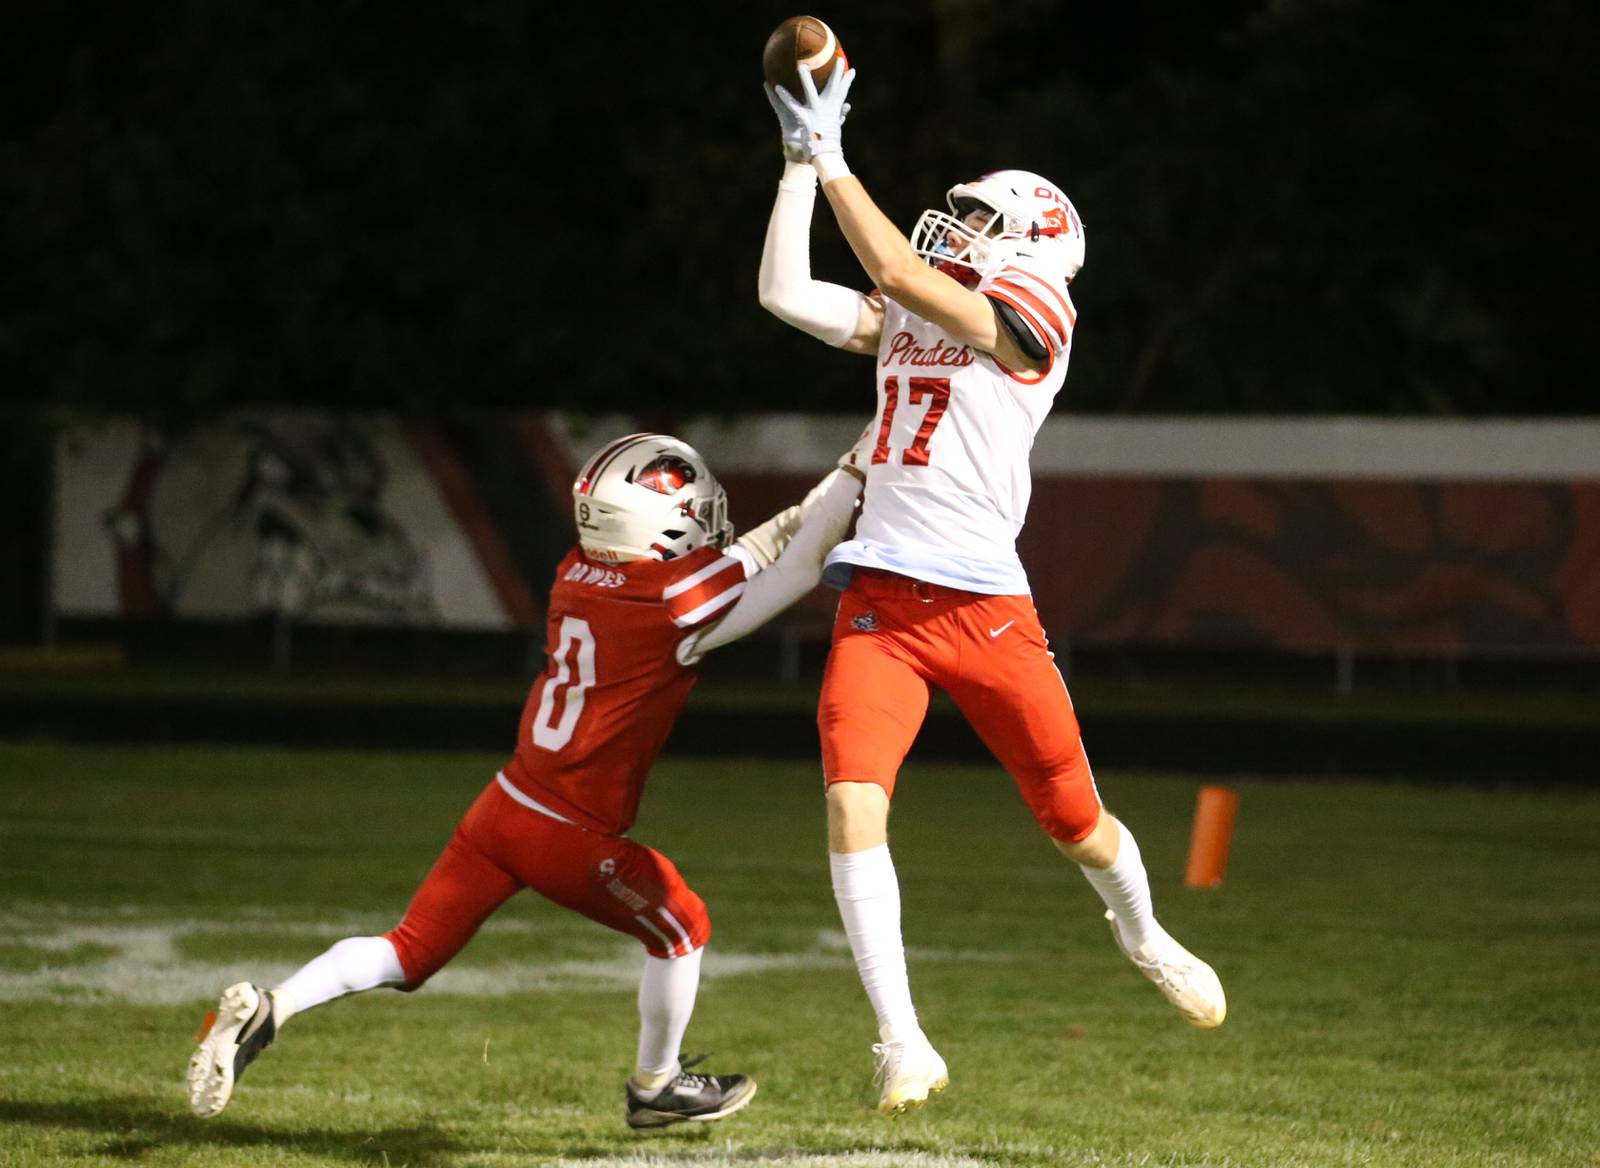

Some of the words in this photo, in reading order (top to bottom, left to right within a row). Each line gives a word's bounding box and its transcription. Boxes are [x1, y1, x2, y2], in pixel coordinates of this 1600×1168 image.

[882, 331, 975, 367] Pirates
[871, 375, 951, 466] 17
[532, 615, 596, 752] 0
